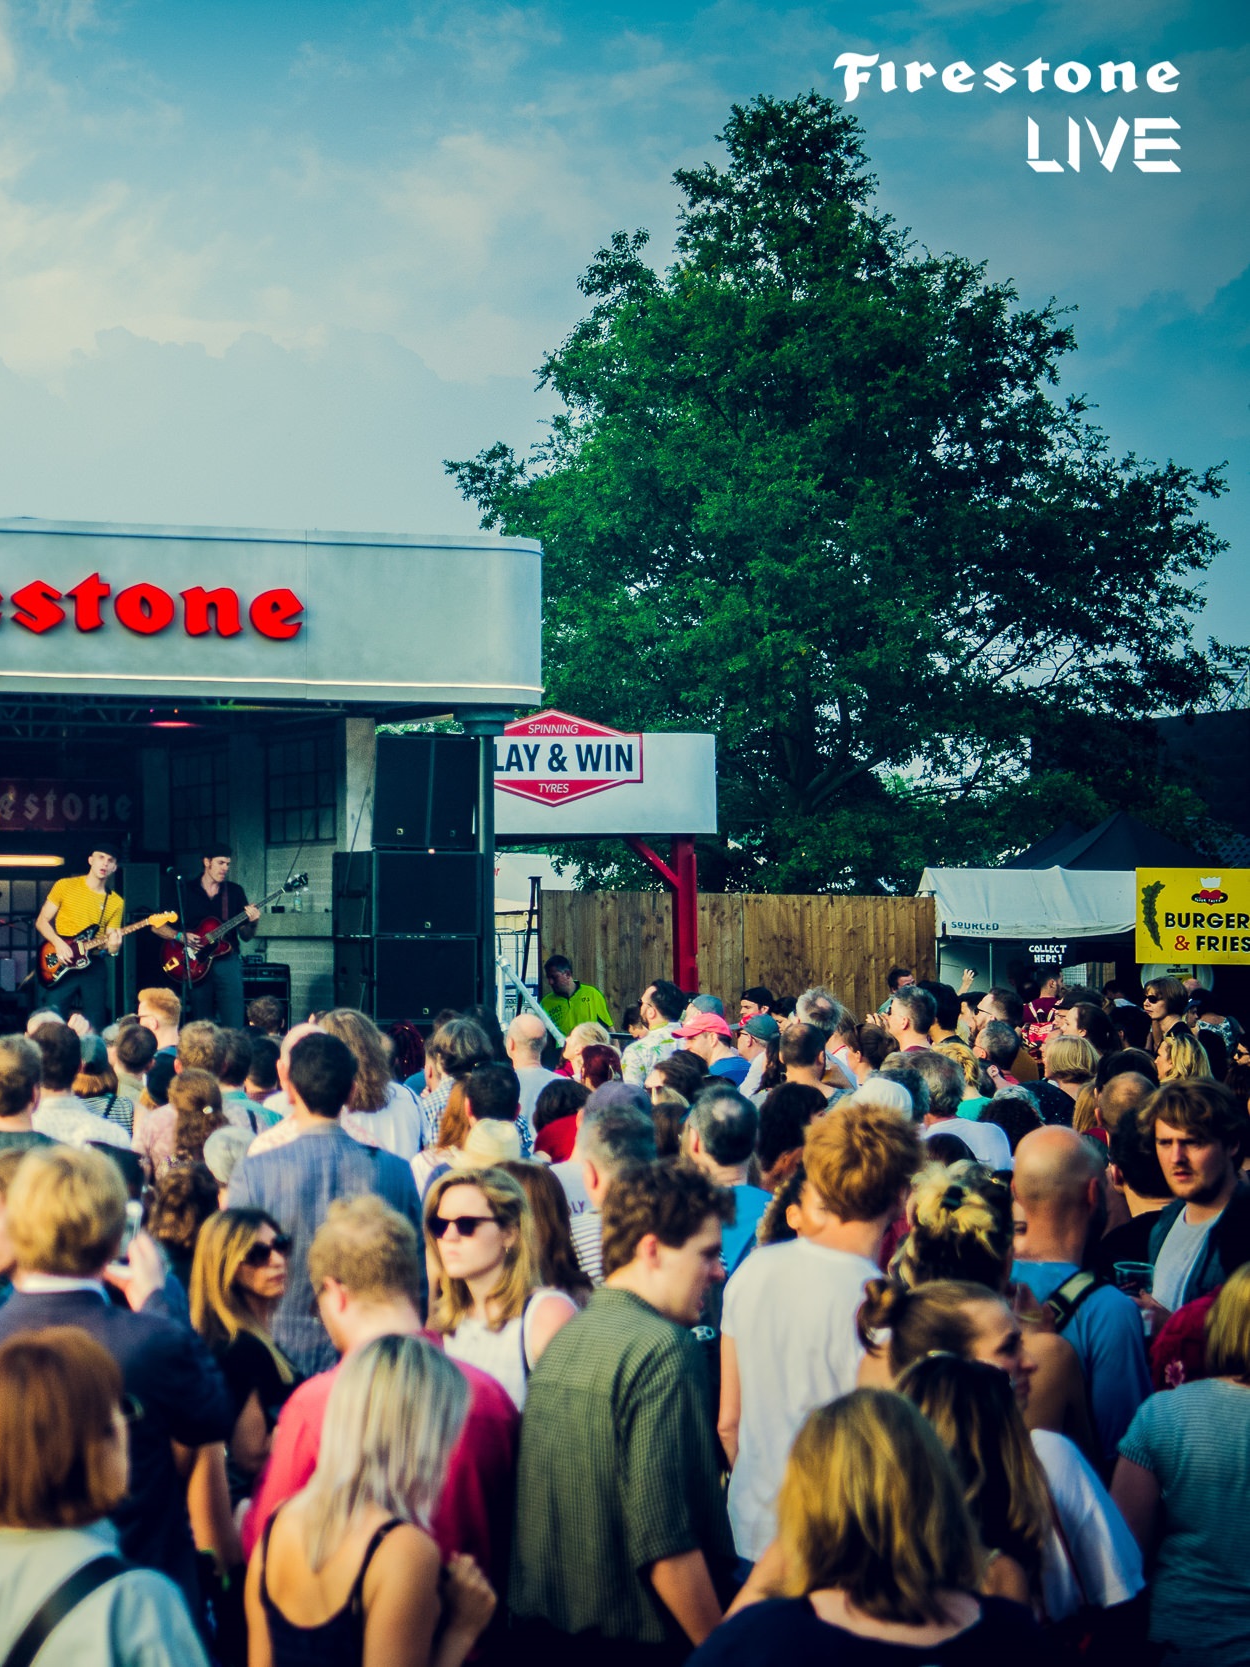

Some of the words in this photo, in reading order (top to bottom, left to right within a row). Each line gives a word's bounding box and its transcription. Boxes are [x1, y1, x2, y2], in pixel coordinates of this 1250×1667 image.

[527, 723, 579, 735] SPINNING
[494, 743, 541, 772] LAY
[547, 743, 568, 773] &
[575, 743, 633, 772] WIN
[538, 783, 570, 794] TYRES
[951, 921, 999, 931] SOURCED
[1165, 912, 1250, 929] BURGER
[1029, 944, 1068, 954] COLLECT
[1174, 935, 1191, 951] &
[1196, 935, 1250, 952] FRIES
